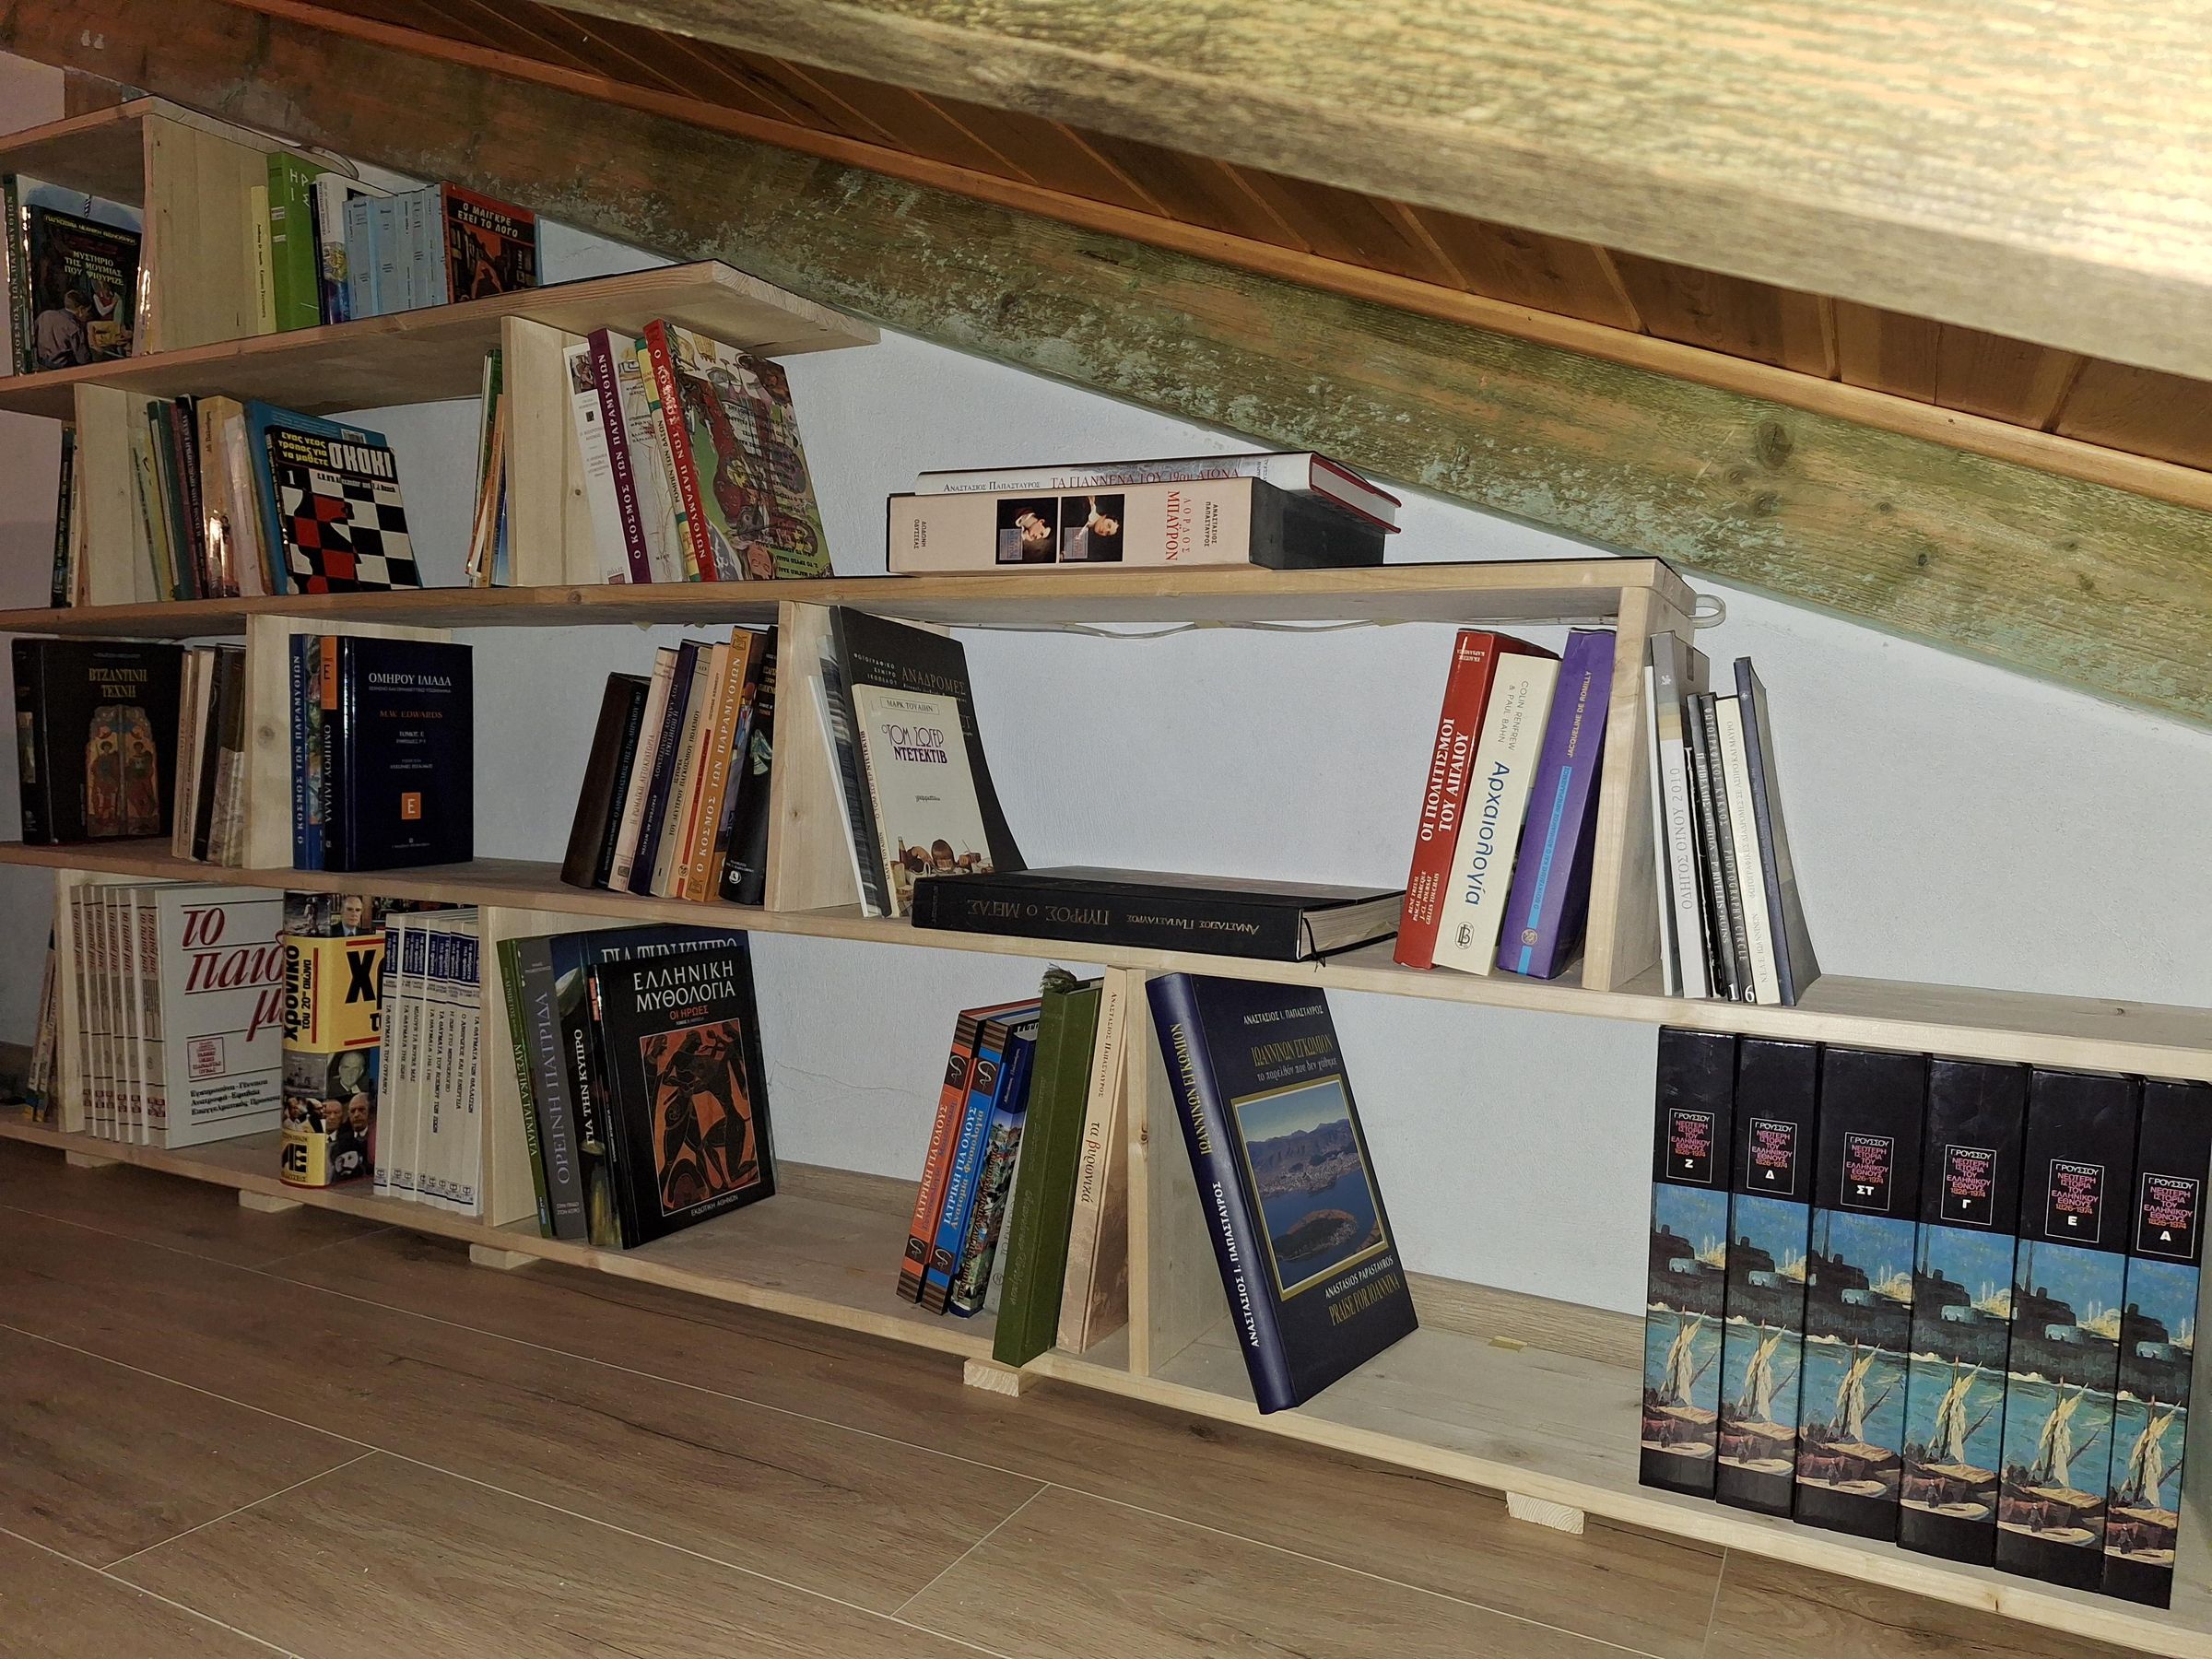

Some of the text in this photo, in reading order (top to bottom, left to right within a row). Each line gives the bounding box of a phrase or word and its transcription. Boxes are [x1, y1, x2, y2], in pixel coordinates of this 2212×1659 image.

[457, 210, 519, 239] ΕΧΕΙ ΤΟ ΛΟΓΟ
[463, 202, 512, 228] Ο ΜΑΙΓΚΡΕ
[64, 256, 123, 277] ΤΗΣ ΜΟΥΜΙΑΣ
[64, 265, 83, 276] ΠΟΥ
[73, 250, 114, 267] ΜΥΣΤΗΡΙΟ
[328, 441, 394, 479] σκακι
[597, 353, 641, 560] Ο ΚΟΣΜΟΣ ΤΩΝ ΠΑΡΑΜΥΘΙΩΝ
[653, 348, 662, 359] Ο
[671, 430, 685, 460] ΤΩΝ
[679, 464, 707, 559] ΠΑΡΑΜΥΘΙΩΝ
[287, 470, 296, 486] 1
[1051, 477, 1066, 489] ΤΑ
[1068, 473, 1135, 488] ΓΙΑΝΝΕΝΑ
[1139, 472, 1165, 484] ΤΟΥ
[1197, 467, 1241, 481] ΑΙΩΝΑ
[1165, 490, 1182, 561] ΜΠΑΫΡΟΝ
[1182, 497, 1192, 553] ΛΟΡΔΟΣ
[1204, 501, 1212, 547] ΠΑΠΑΣΤΑΥΡΟΣ
[1211, 503, 1219, 545] ΑΝΑΣΤΑΣΙΟΣ
[100, 684, 137, 699] ΤΕΧΝΗ
[368, 672, 453, 688] ΟΜΗΡΟΥ ΙΛΙΑΔΑ
[900, 665, 967, 697] ΑΝΑΔΡΟΜΕΣ
[292, 654, 302, 740] ΠΑΡΑΜΥΘΙΩΝ
[717, 656, 742, 756] ΠΑΡΑΜΥΘΙΩΝ
[886, 699, 905, 711] ΜΑΡΚ
[1498, 684, 1516, 744] & PAUL BAHN
[1508, 678, 1530, 753] COLIN RENFREW
[1567, 670, 1593, 759] JACQUELINE DE ROMILLY
[887, 724, 913, 746] ΤΟΜ
[912, 726, 945, 748] ΣΩΓΕΡ
[294, 746, 303, 771] ΤΩΝ
[893, 746, 948, 765] ΝΤΕΤΕΚΤΙΒ
[323, 724, 334, 823] ΟΜΗΡΟΥ ΙΛΙΑΔΑ
[709, 760, 724, 789] ΤΩΝ
[1420, 717, 1455, 842] ΟΙ ΠΟΛΙΤΙΣΜΟΙ
[1438, 731, 1469, 833] ΤΟΥ ΑΙΓΑΙΟΥ
[295, 776, 304, 830] ΚΟΣΜΟΣ
[406, 798, 417, 815] Ε
[698, 795, 717, 858] ΚΟΣΜΟΣ
[1465, 760, 1511, 906] Αρχαιολογία
[1669, 768, 1693, 910] ΟΔΗΓΟΣ ΟΙΝΟΥ 2010
[1703, 707, 1748, 961] ΦΩΤΟΓΡΑΦΙΚΟΣ ΚΥΚΛΟΣ PHOTOGRAPHY CIRCLE
[696, 862, 704, 873] Ο
[1697, 764, 1729, 944] ΡΙΒΕΛΛΗΣ RIVELLIS RUINS
[1413, 870, 1428, 923] PASCAL DARCQUE
[1425, 873, 1440, 925] GILLES TOUCHAIS
[182, 907, 225, 948] το
[185, 929, 285, 993] παιδ
[633, 959, 735, 992] ΕΛΛΗΝΙΚΗ
[636, 980, 736, 1013] ΜΥΘΟΛΟΓΙΑ
[1728, 983, 1738, 1001] 1
[1744, 984, 1756, 1003] 6
[301, 1011, 312, 1030] του
[669, 1005, 710, 1020] ΟΙ ΗΡΩΕΣ
[1242, 1010, 1280, 1025] ΑΝΑΣΤΑΣΙΟΣ
[1285, 1004, 1324, 1019] ΠΑΠΑΣΤΑΥΡΟΣ
[535, 992, 559, 1088] ΠΑΤΡΙΔΑ
[1098, 993, 1118, 1098] ΑΝΑΣΤΑΣΙΟΣ ΠΑΠΑΣΤΑΥΡΟΣ
[1250, 1032, 1334, 1067] ΙΩΑΝΝΙΝΩΝ ΕΓΚΩΜΙΟΝ
[1256, 1056, 1338, 1082] το παρελθόν που δεν χάθηκε
[513, 1043, 538, 1158] ΜΥΣΤΙΚΑ ΤΑΓΜΑΤΑ
[573, 1029, 595, 1145] ΓΙΑ ΤΗΝ ΚΥΠΡΟ
[1171, 1023, 1213, 1156] ΙΩΑΝΝΙΝΩΝ ΕΓΚΩΜΙΟΝ
[547, 1097, 571, 1185] ΟΡΕΙΝΗ
[915, 1104, 948, 1220] ΙΑΤΡΙΚΗ ΓΙΑ ΟΛΟΥΣ
[943, 1106, 977, 1225] ΙΑΤΡΙΚΗ ΓΙΑ ΟΛΟΥΣ
[949, 1109, 984, 1230] Ανατομία Φυσιολογία
[1080, 1122, 1101, 1204] τα βυρωνικά
[1684, 1158, 1695, 1169] Ζ
[1764, 1169, 1775, 1181] Δ
[2056, 1172, 2098, 1184] ΝΕΩΤΕΡΗ
[1856, 1184, 1876, 1196] ΣΤ
[2051, 1189, 2100, 1203] ΕΛΛΗΝΙΚΟΥ
[2060, 1179, 2092, 1190] ΙΣΤΟΡΙΑ
[2067, 1185, 2085, 1195] ΤΟΥ
[2149, 1186, 2192, 1198] ΝΕΩΤΕΡΗ
[2153, 1194, 2187, 1205] ΙΣΤΟΡΙΑ
[1961, 1198, 1972, 1209] Γ
[2054, 1203, 2094, 1215] 1826-1974
[2057, 1197, 2092, 1208] ΕΘΝΟΥΣ
[2143, 1204, 2194, 1218] ΕΛΛΗΝΙΚΟΥ
[2149, 1212, 2186, 1223] ΕΘΝΟΥΣ
[2160, 1200, 2179, 1209] ΤΟΥ
[2067, 1214, 2078, 1227] Ε
[2147, 1218, 2188, 1230] 1826-1974
[2159, 1230, 2172, 1242] Α
[1212, 1180, 1261, 1347] ΑΝΑΣΤΑΣΙΟΣ Ι. ΠΑΠΑΣΤΑΥΡΟΣ
[1324, 1254, 1394, 1300] ANASTASIOS PAPASTAVROS
[1328, 1272, 1401, 1326] PRAISE FOR IOANNINA
